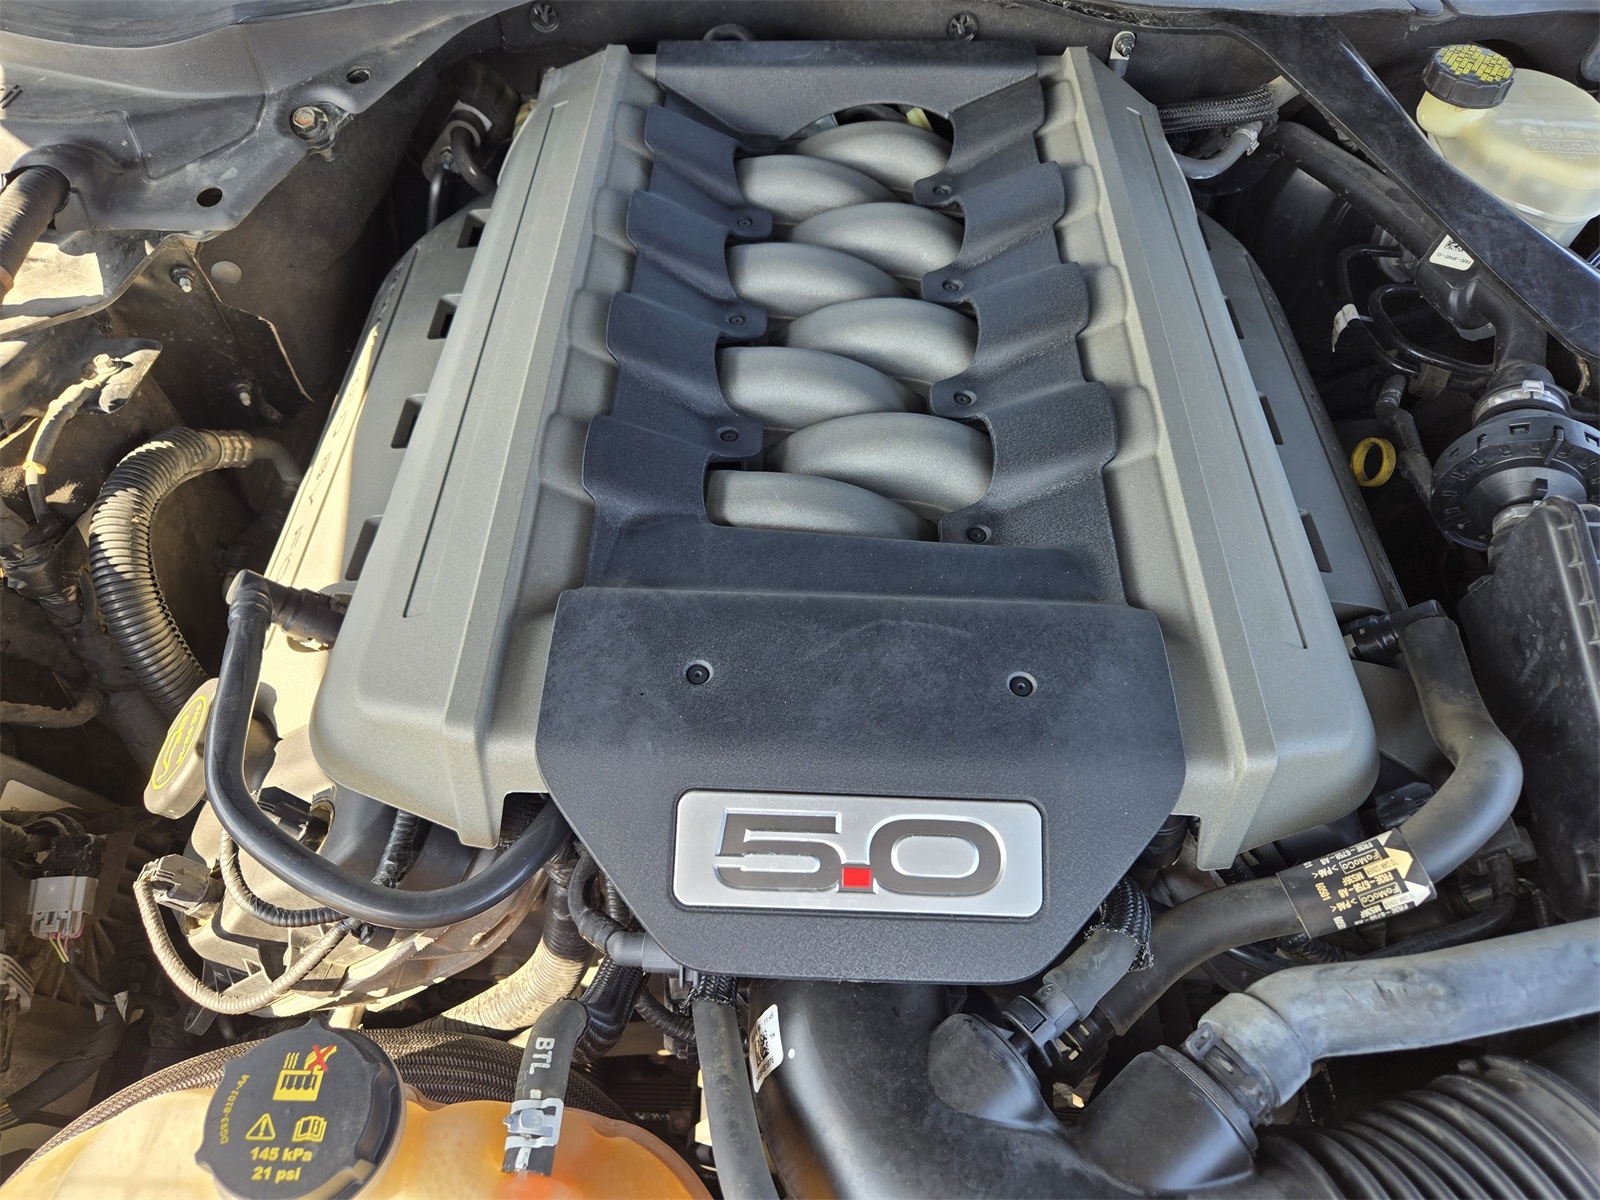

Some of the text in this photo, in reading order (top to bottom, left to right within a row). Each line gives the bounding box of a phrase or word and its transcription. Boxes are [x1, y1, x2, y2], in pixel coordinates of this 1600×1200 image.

[713, 807, 1007, 897] 5.0
[1341, 851, 1382, 872] FoMoCo
[1360, 883, 1401, 905] FoMoCo
[528, 1036, 556, 1075] BTL
[219, 1073, 250, 1145] DG93-8101-AA
[250, 1147, 313, 1162] 145 kPa
[251, 1166, 302, 1184] 21 psi
